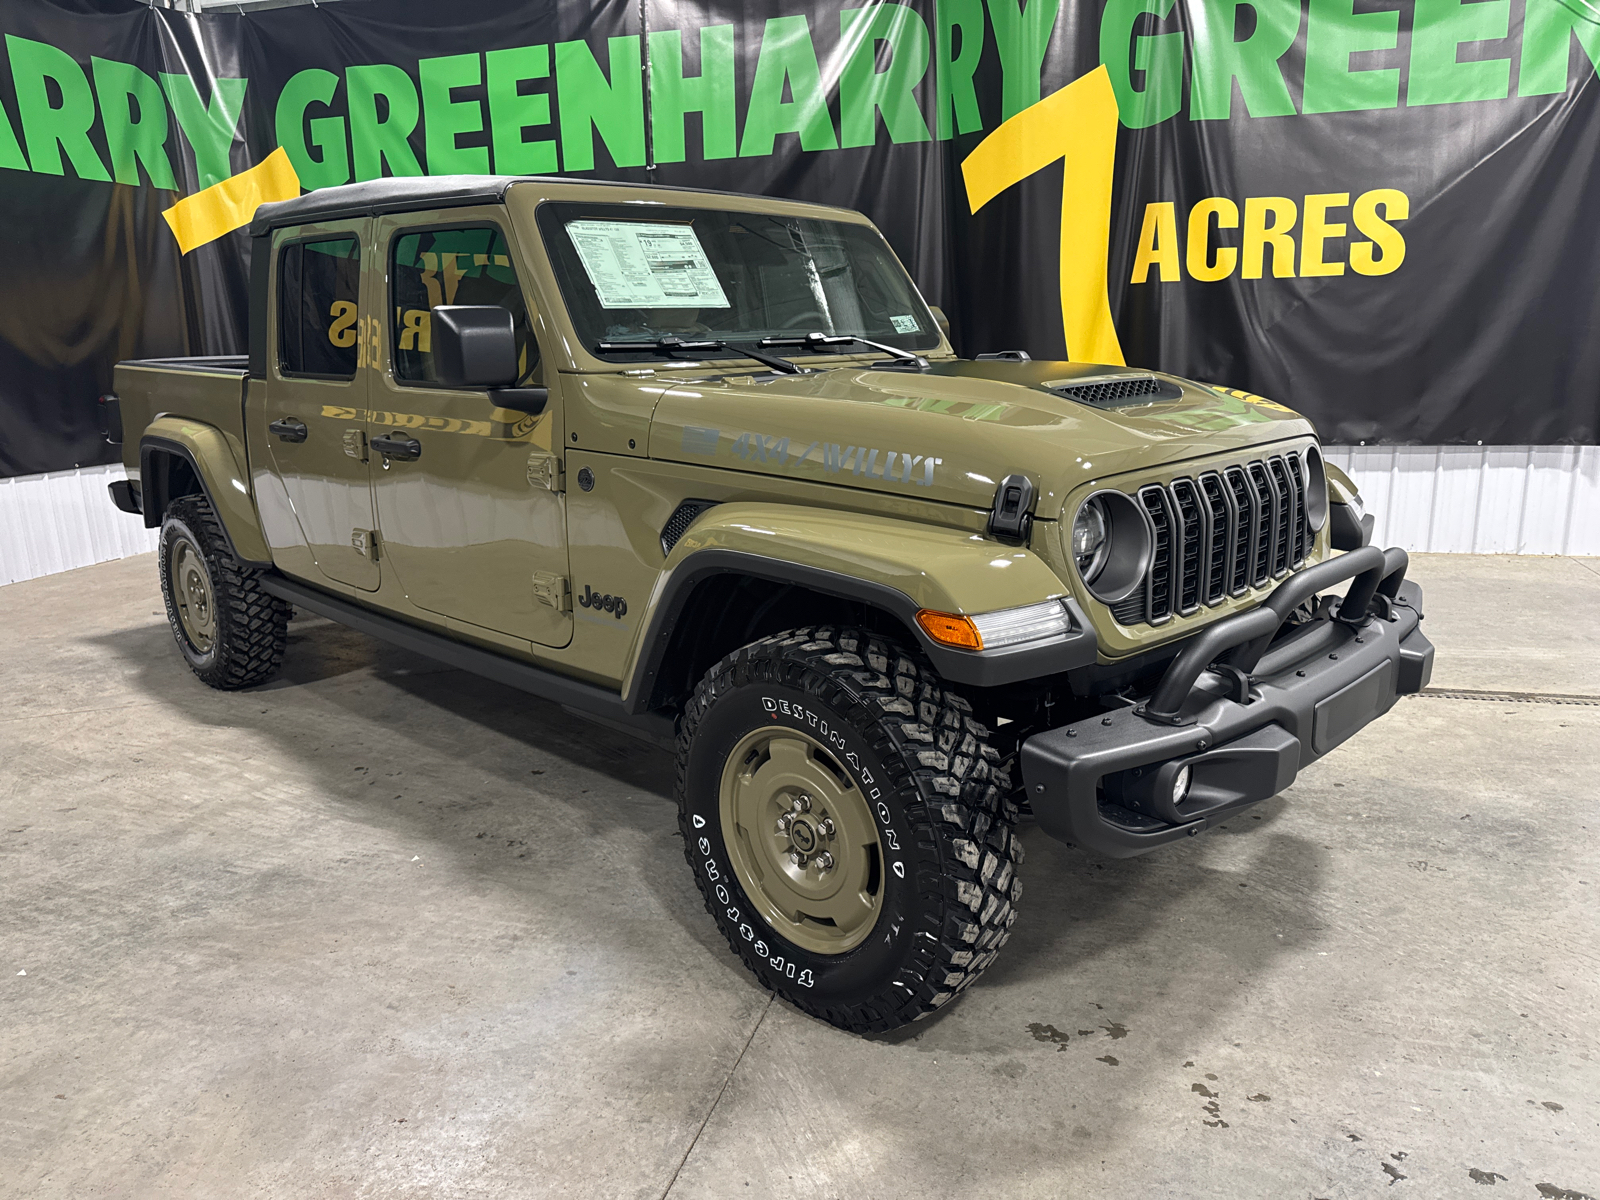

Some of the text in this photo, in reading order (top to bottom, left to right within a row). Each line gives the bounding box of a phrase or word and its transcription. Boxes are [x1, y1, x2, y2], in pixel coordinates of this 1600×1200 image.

[0, 33, 647, 192] RRY GREEN
[648, 0, 1060, 164] HARRY
[960, 63, 1409, 366] 7 ACRES
[578, 584, 628, 619] Jeep
[761, 697, 901, 850] DESTINATION
